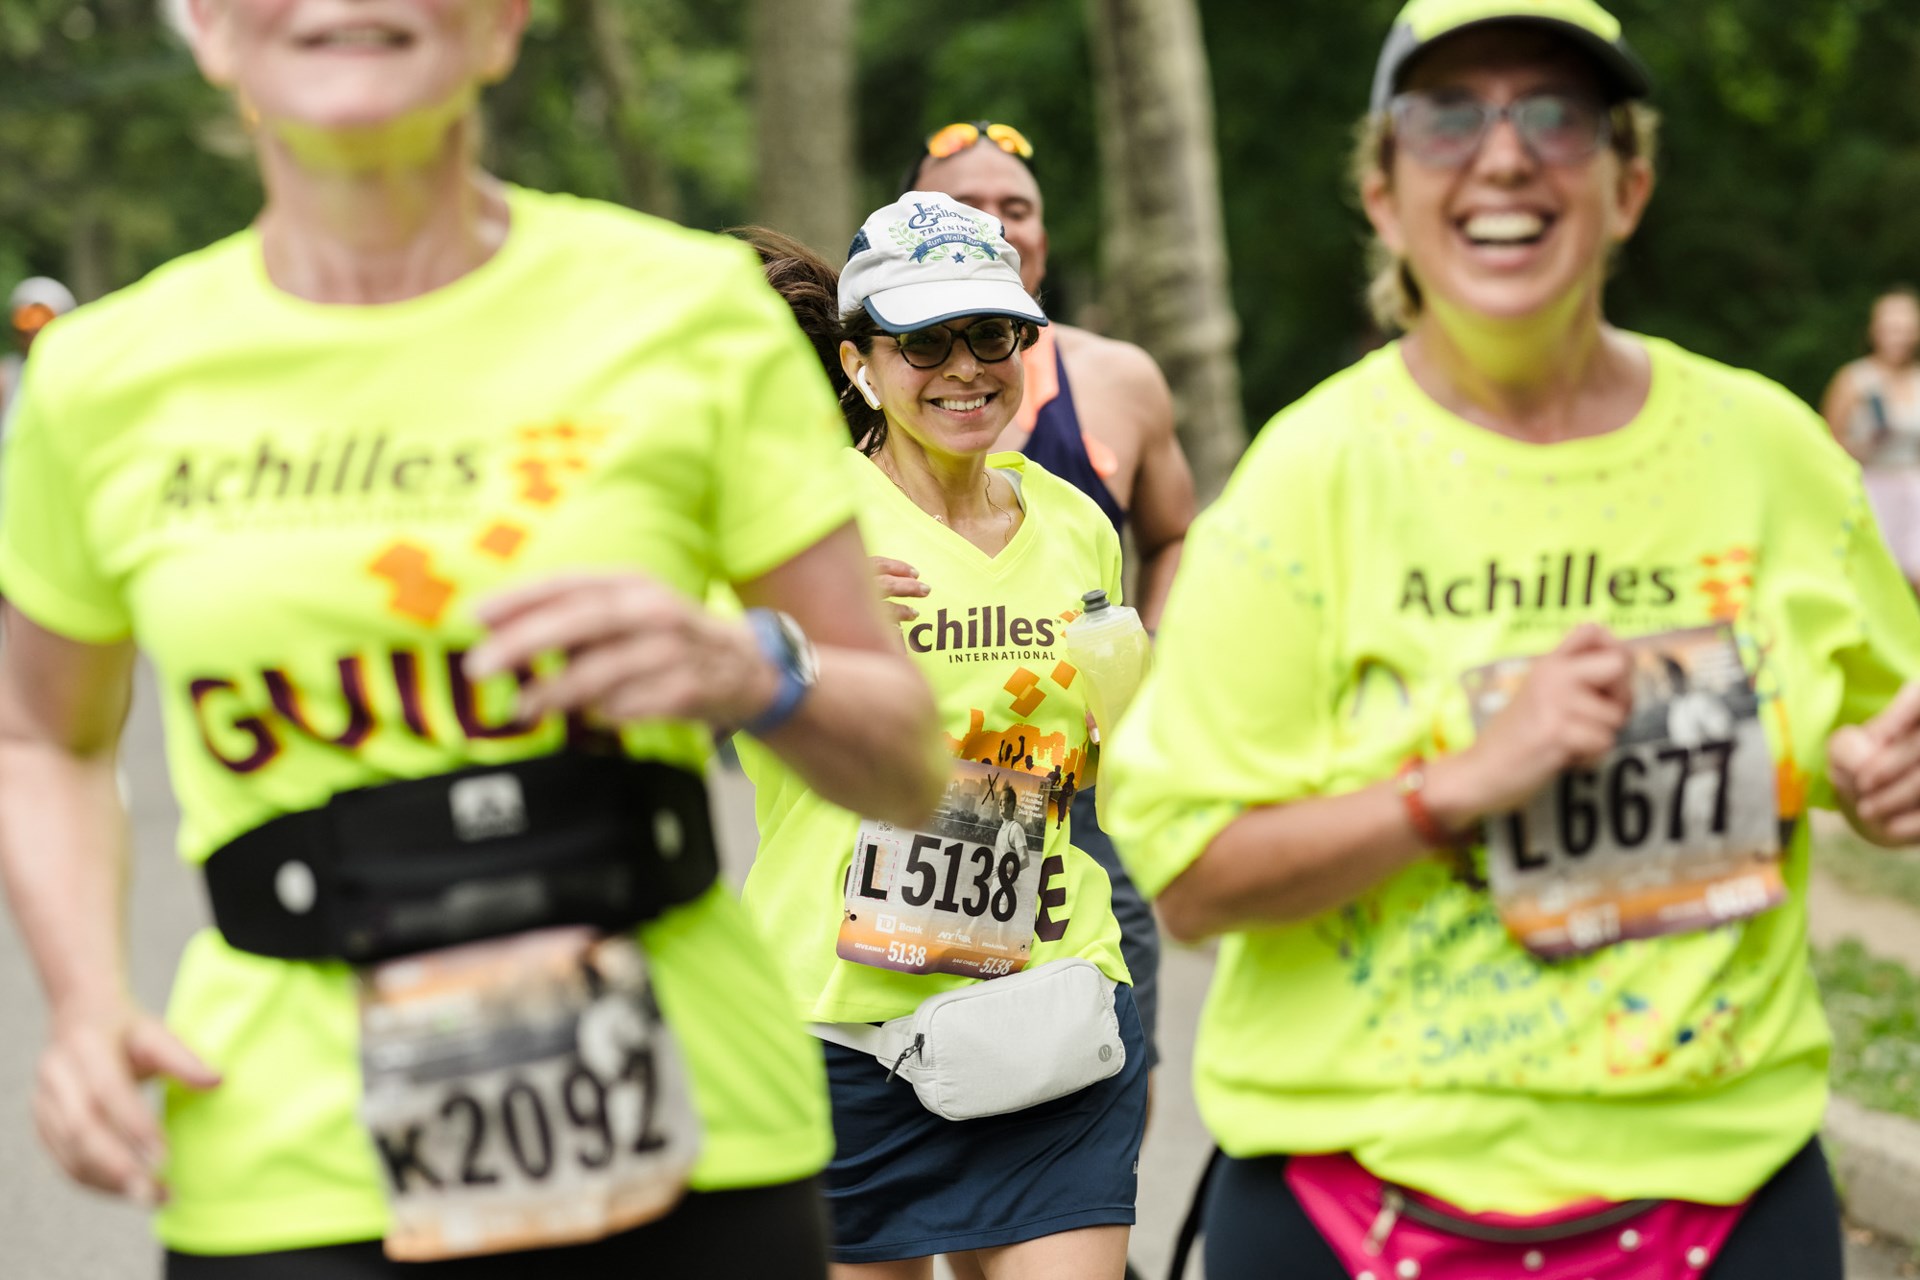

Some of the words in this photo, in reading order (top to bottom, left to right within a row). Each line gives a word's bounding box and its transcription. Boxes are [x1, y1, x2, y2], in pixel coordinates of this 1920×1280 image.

[913, 202, 941, 224] Jeff
[920, 225, 979, 236] TRAINING
[926, 237, 942, 247] Run
[966, 237, 982, 246] Run
[163, 432, 480, 508] Achilles
[1400, 552, 1678, 617] Achilles
[903, 605, 1055, 653] chilles
[949, 651, 1056, 664] INTERNATIONAL
[188, 650, 623, 773] GUID
[1558, 738, 1738, 857] 6677
[859, 844, 888, 900] L
[901, 834, 1021, 922] 5138
[899, 922, 924, 934] Bank
[855, 943, 886, 954] GIVEAWAY
[888, 941, 927, 966] 5138
[979, 957, 1014, 975] 5138
